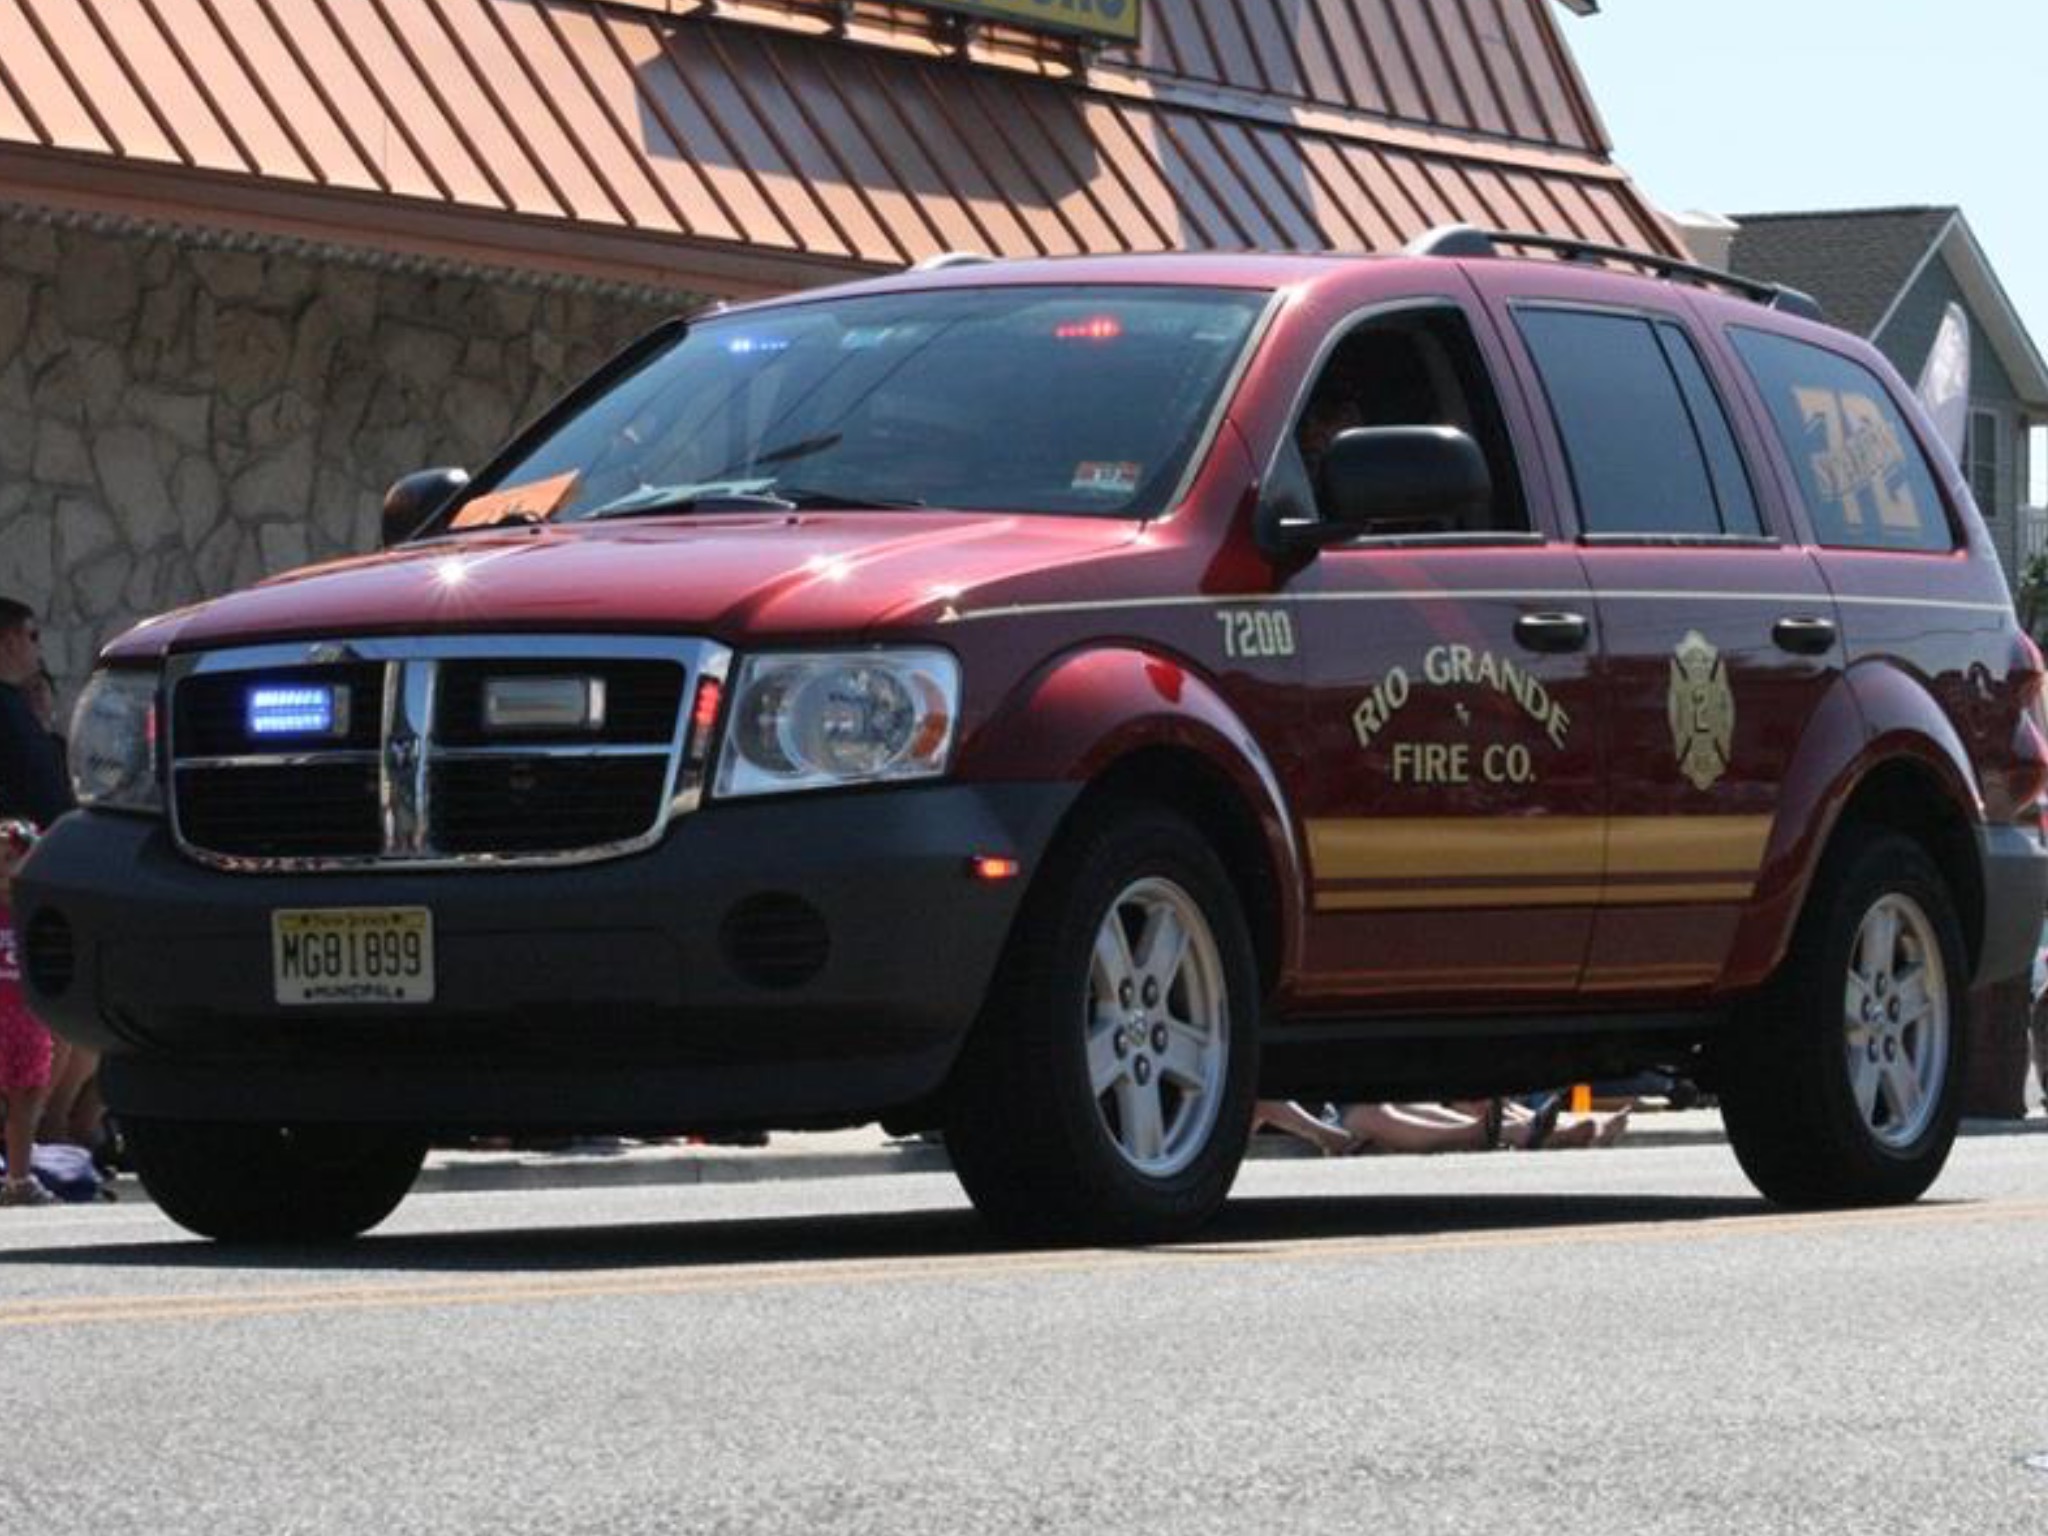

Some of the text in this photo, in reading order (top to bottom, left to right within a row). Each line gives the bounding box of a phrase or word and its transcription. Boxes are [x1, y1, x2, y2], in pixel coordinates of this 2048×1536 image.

[1790, 385, 1922, 528] 72
[1216, 609, 1295, 657] 7200
[1351, 644, 1571, 750] RIO GRANDE
[1393, 743, 1537, 783] FIRE CO.
[281, 930, 422, 979] MG81899
